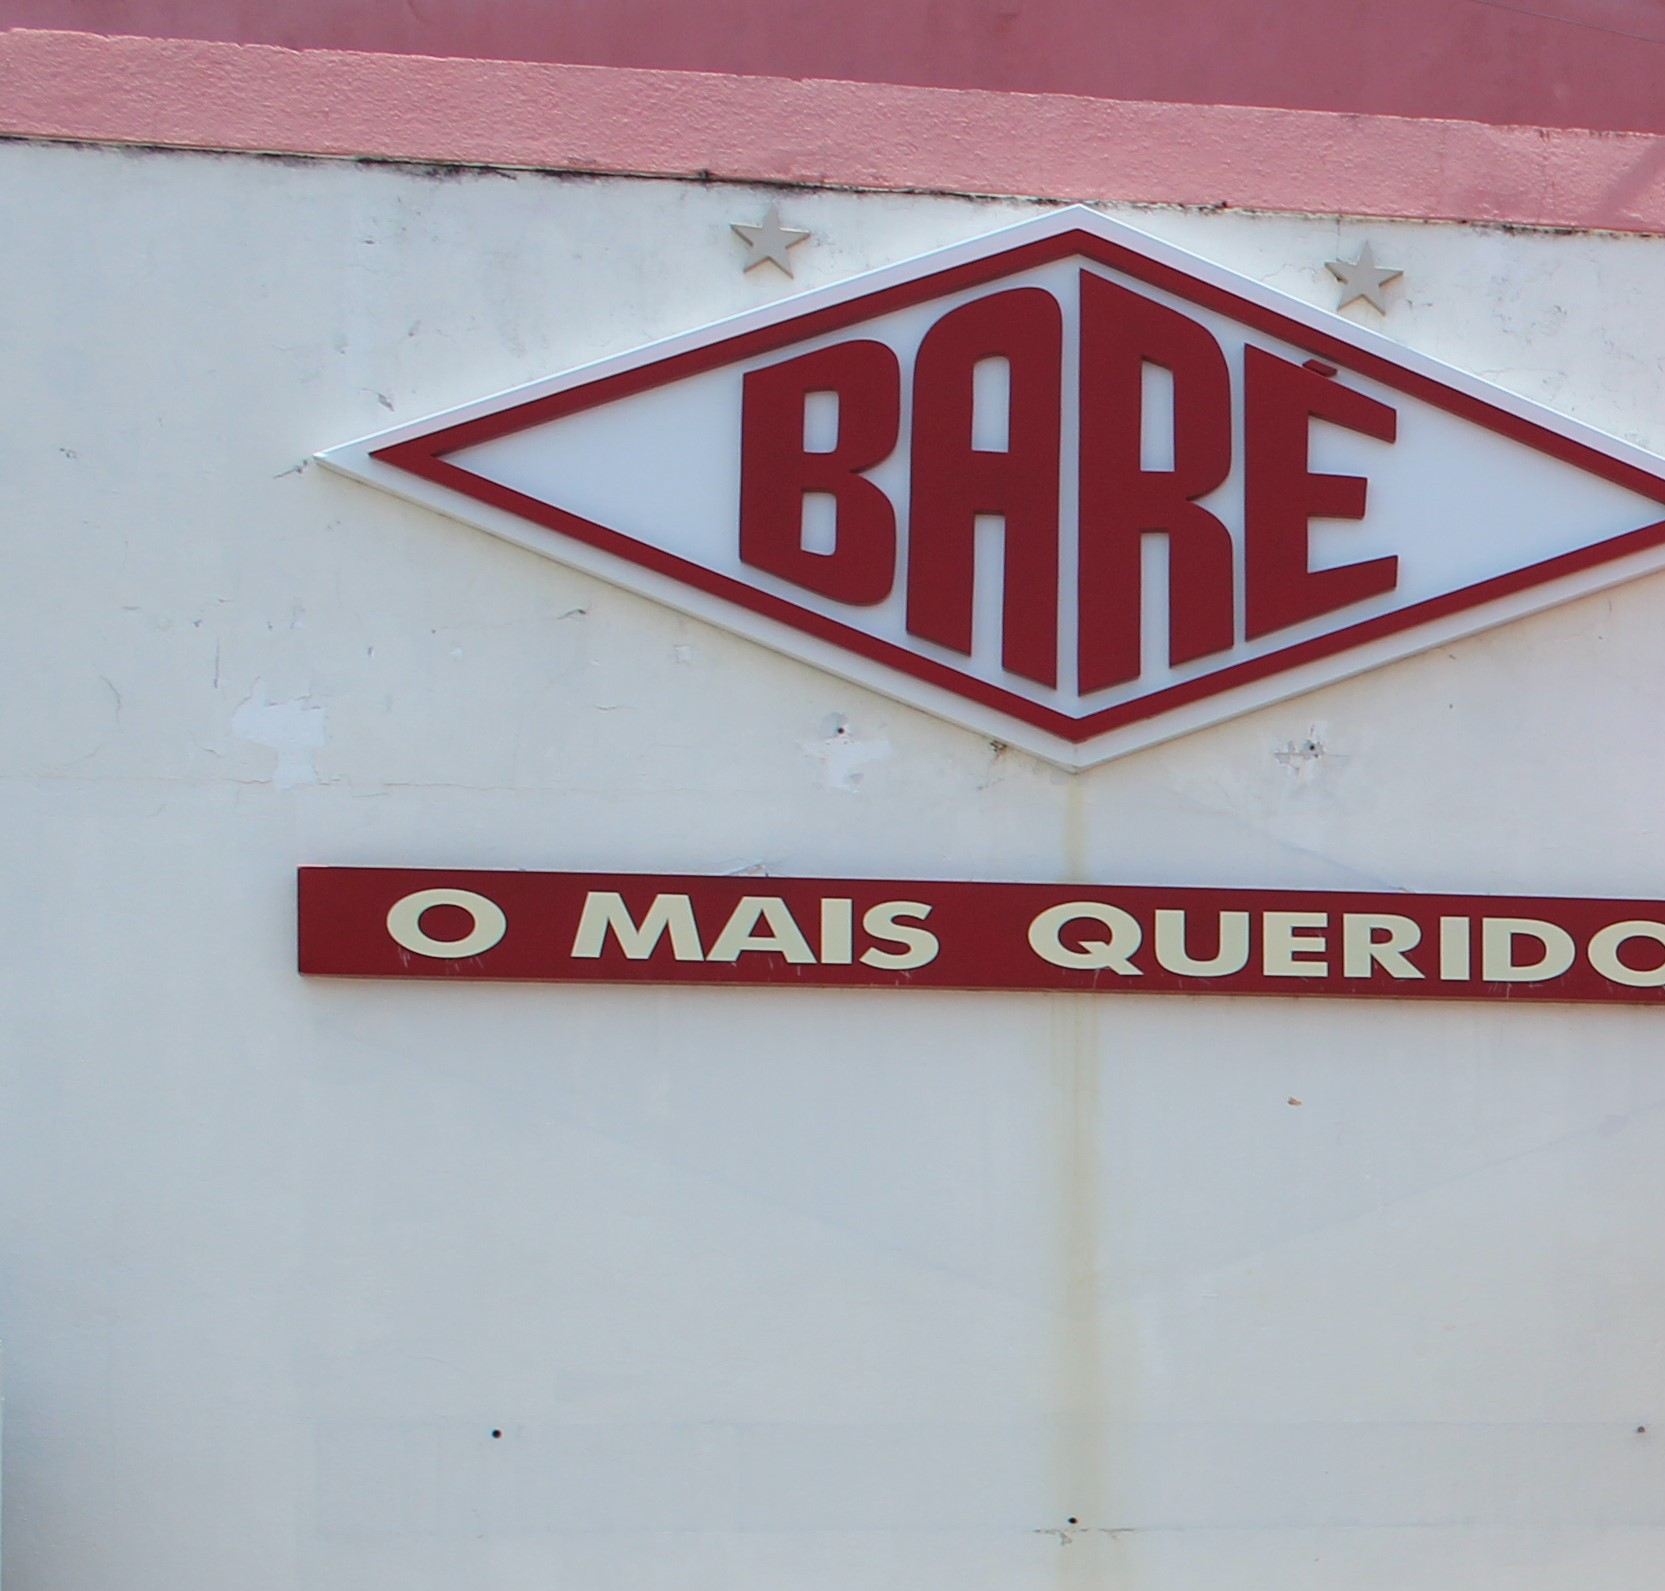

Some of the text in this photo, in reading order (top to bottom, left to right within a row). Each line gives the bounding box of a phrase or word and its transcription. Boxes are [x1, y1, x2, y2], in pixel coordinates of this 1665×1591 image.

[741, 268, 1399, 694] BARÉ
[386, 888, 506, 958] O
[571, 891, 939, 970] MAIS
